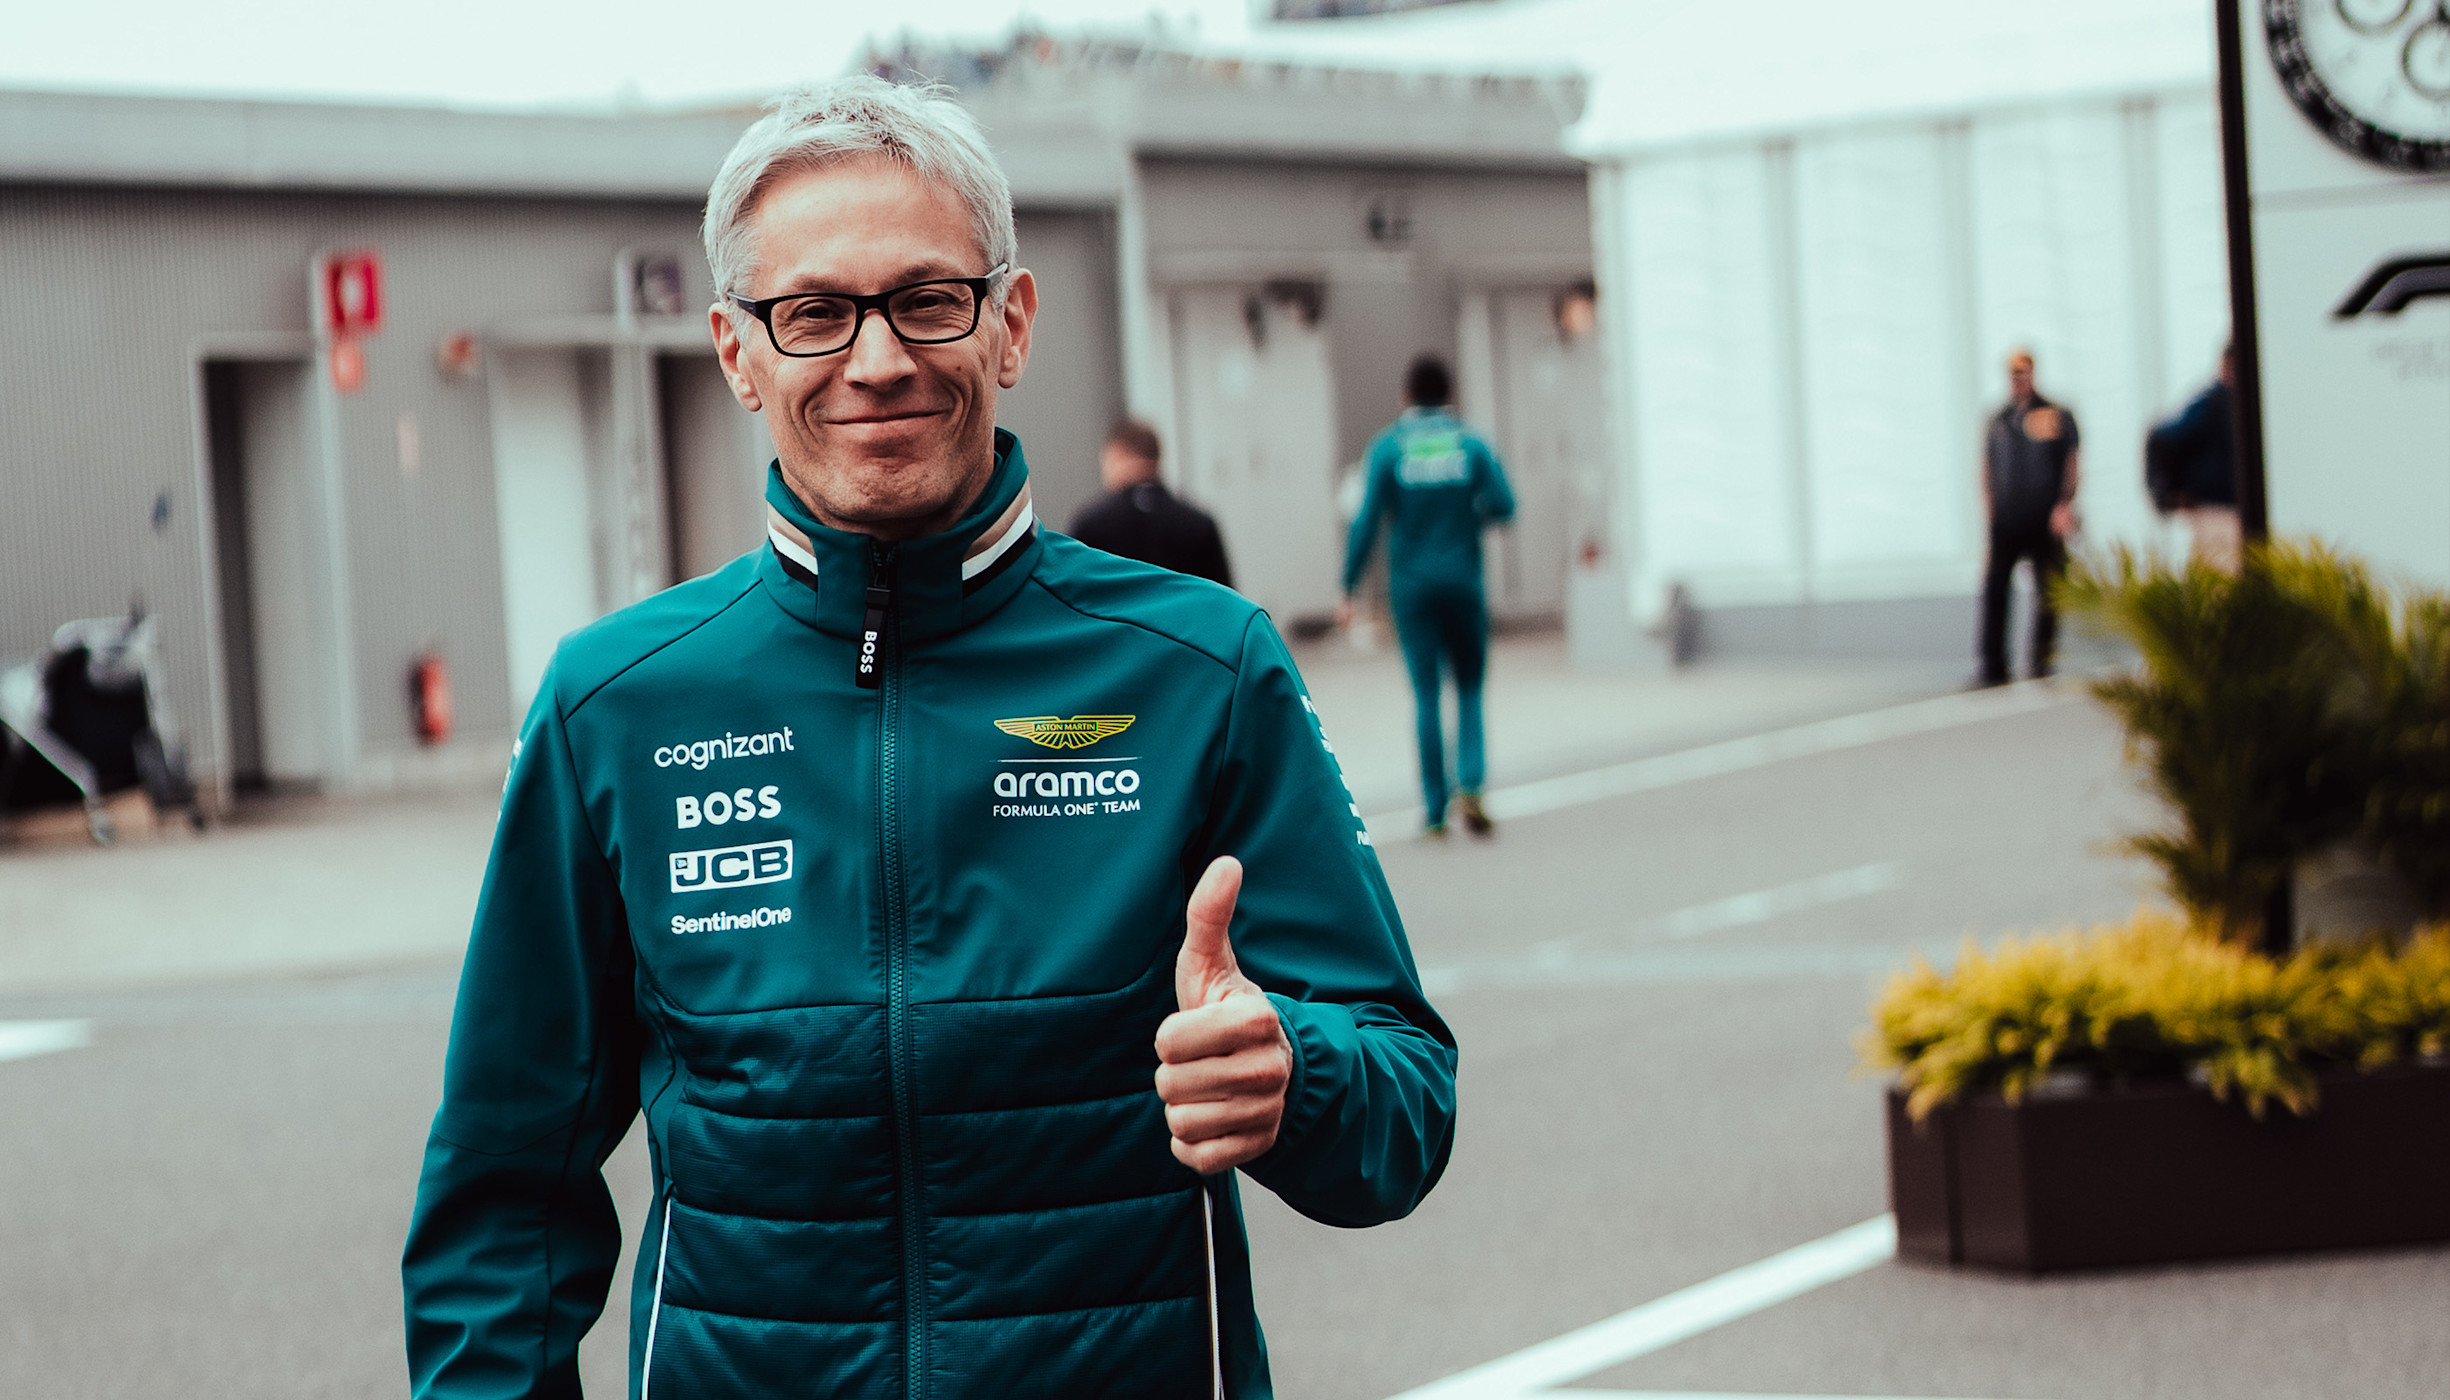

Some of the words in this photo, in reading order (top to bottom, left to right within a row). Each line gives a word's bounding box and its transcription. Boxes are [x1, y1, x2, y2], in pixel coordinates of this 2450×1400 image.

[860, 630, 878, 674] BOSS
[1035, 722, 1063, 732] ASTON
[1064, 722, 1096, 732] MARTIN
[653, 726, 795, 771] cognizant
[993, 769, 1140, 798] aramco
[676, 785, 782, 830] BOSS
[993, 804, 1061, 817] FORMULA
[1102, 799, 1141, 814] TEAM
[675, 845, 789, 887] JCB
[671, 907, 792, 935] SentinelOne
